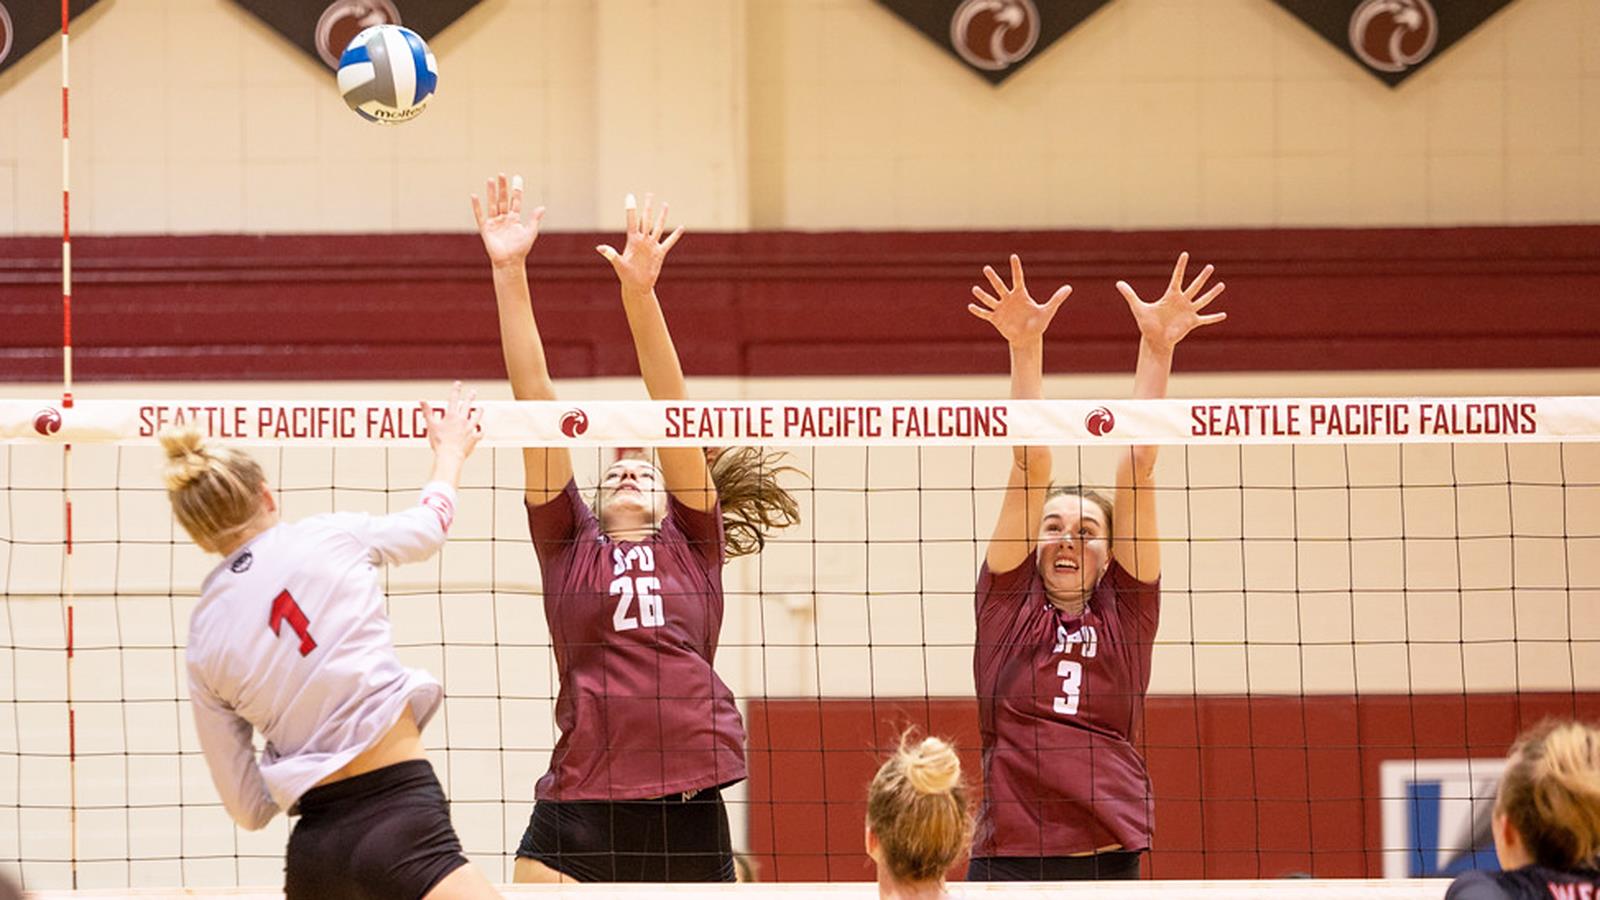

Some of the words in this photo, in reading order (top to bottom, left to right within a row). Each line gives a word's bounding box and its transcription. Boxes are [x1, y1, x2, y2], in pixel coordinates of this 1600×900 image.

[258, 407, 355, 439] PACIFIC
[366, 407, 482, 439] FALC
[665, 407, 773, 438] SEATTLE
[783, 406, 882, 438] PACIFIC
[892, 406, 1008, 438] FALCONS
[1191, 405, 1300, 436] SEATTLE
[1310, 404, 1409, 436] PACIFIC
[1419, 403, 1537, 435] FALCONS
[613, 545, 655, 576] SPU
[609, 576, 665, 632] 26
[1053, 660, 1082, 715] 3
